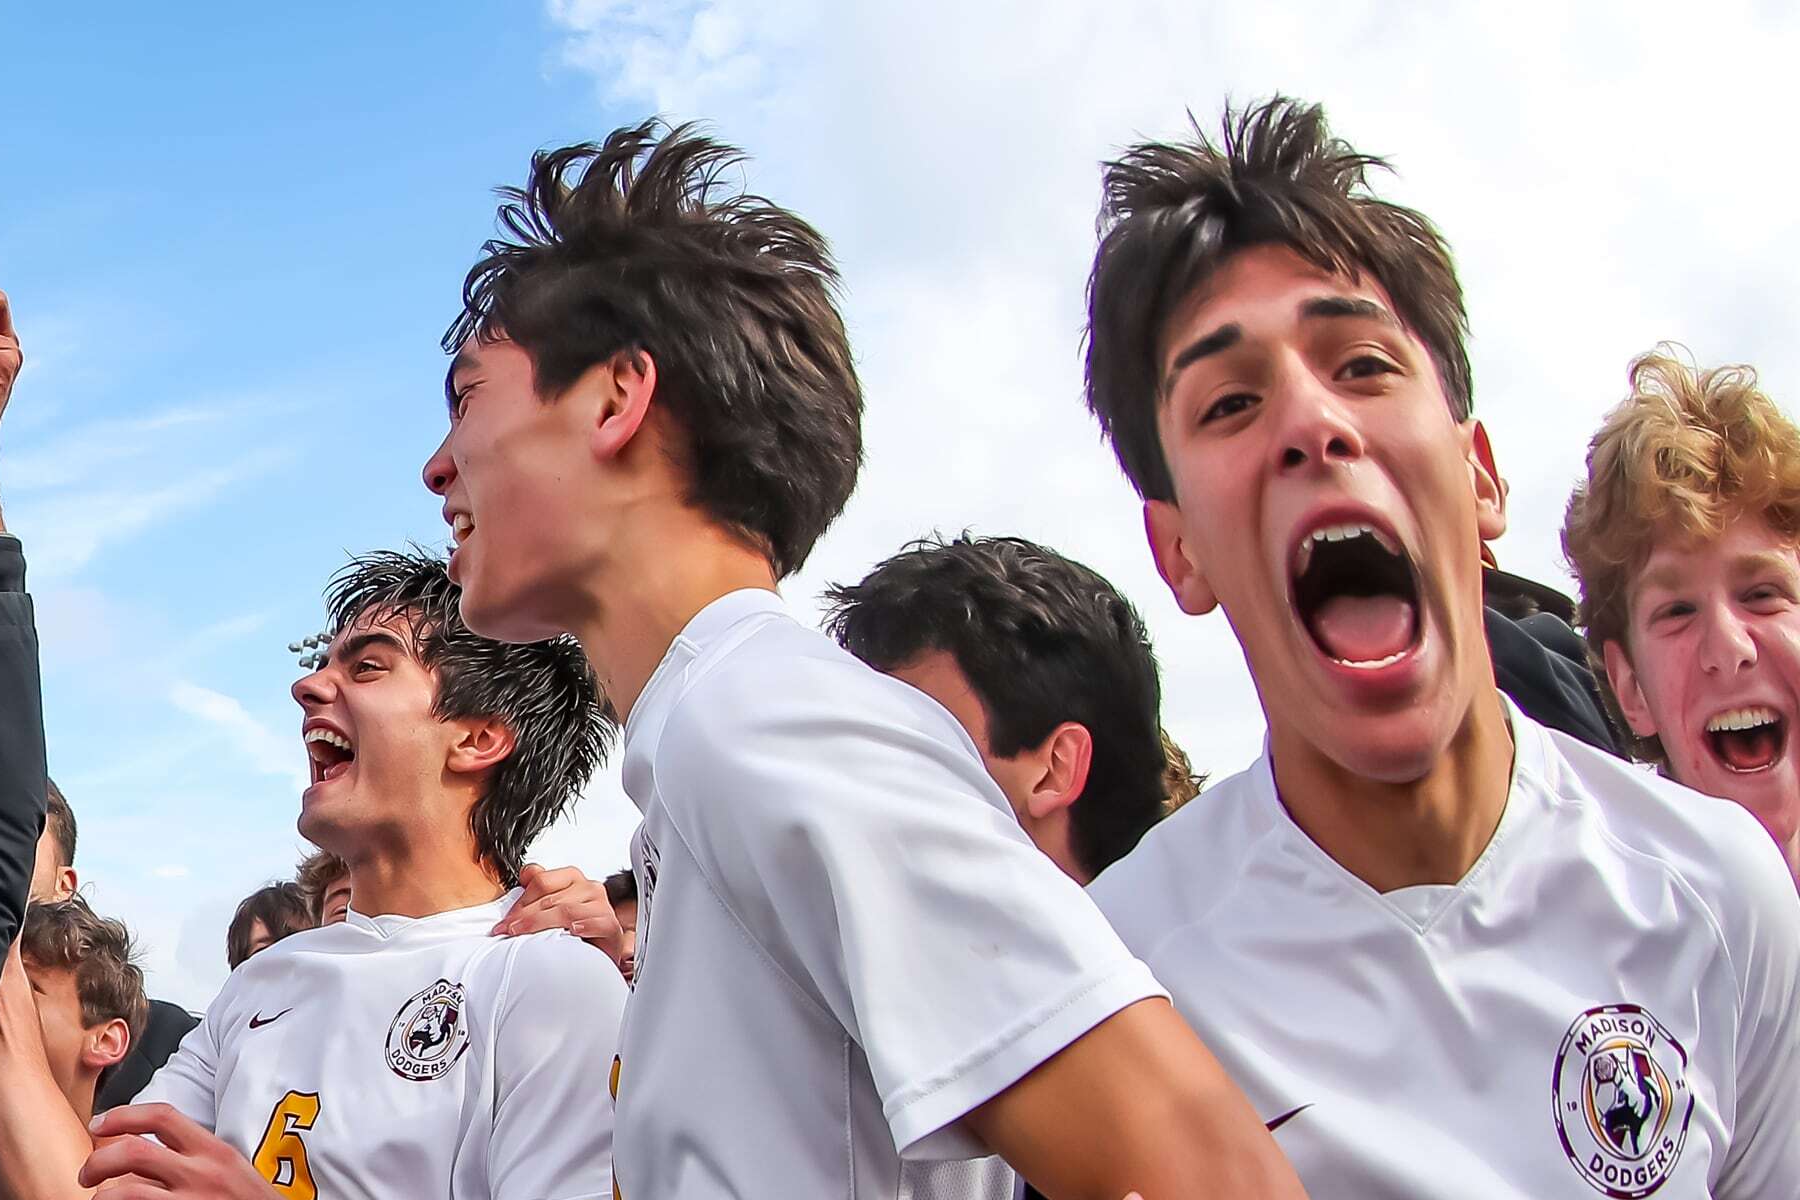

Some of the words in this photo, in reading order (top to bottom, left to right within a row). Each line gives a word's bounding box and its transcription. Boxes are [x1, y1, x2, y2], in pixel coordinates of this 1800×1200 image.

[1575, 1018, 1656, 1057] MADISON
[391, 1049, 447, 1074] DODGERS
[1589, 1136, 1675, 1187] DODGERS
